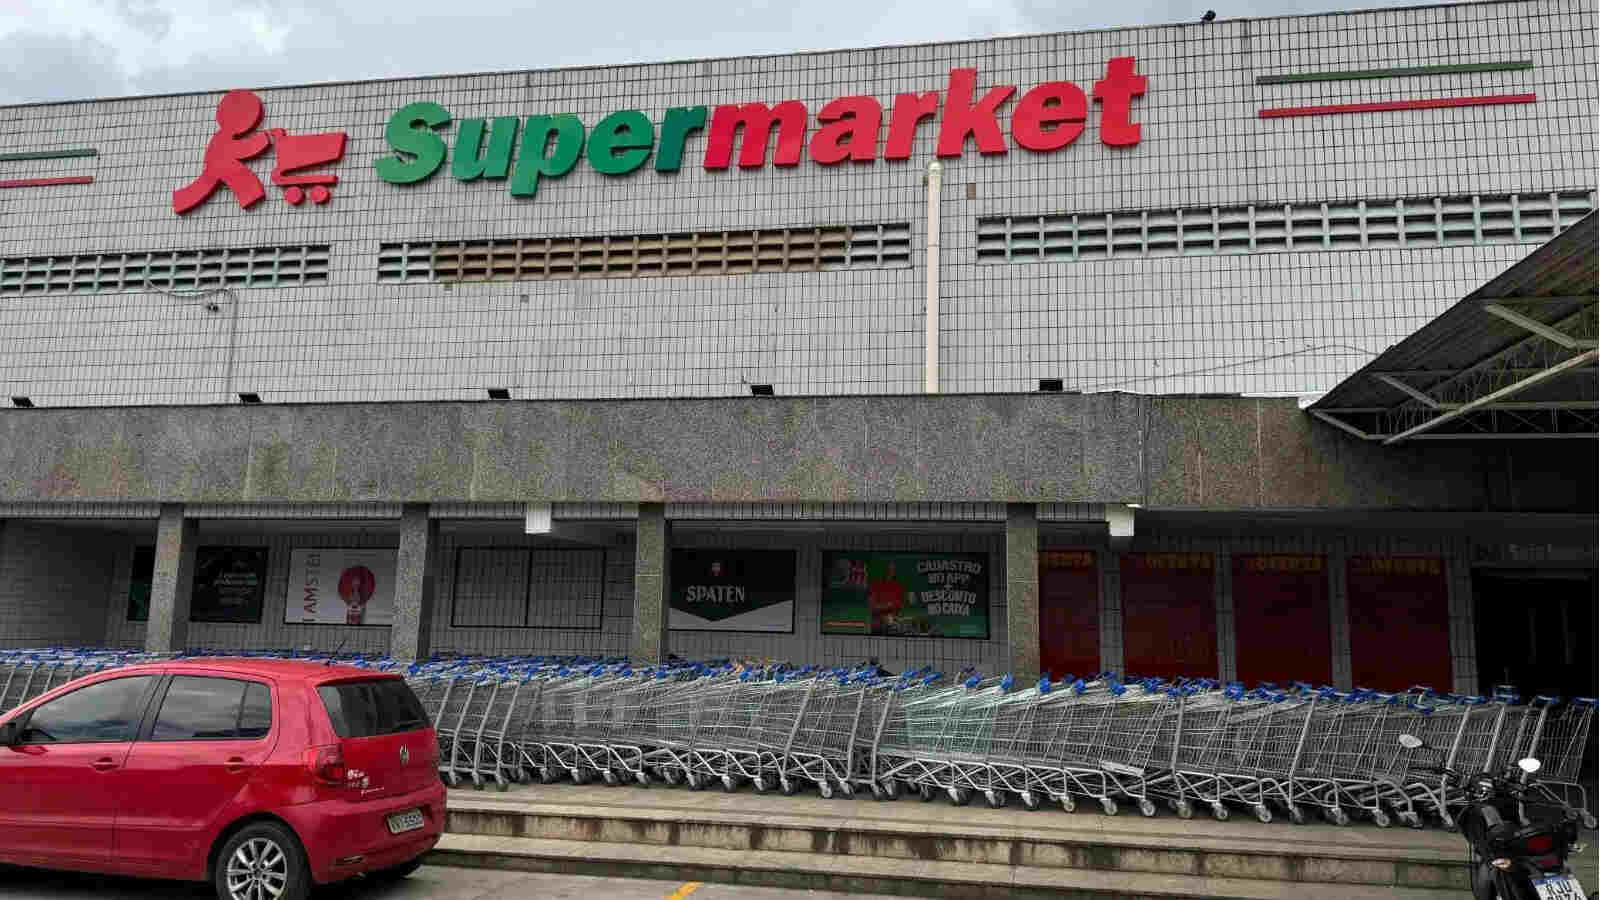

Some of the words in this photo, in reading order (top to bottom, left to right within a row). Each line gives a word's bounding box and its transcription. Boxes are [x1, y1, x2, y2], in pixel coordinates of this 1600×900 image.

[375, 56, 1147, 198] Supermarket
[687, 584, 745, 602] SPATEN
[920, 590, 977, 605] DESCONTO
